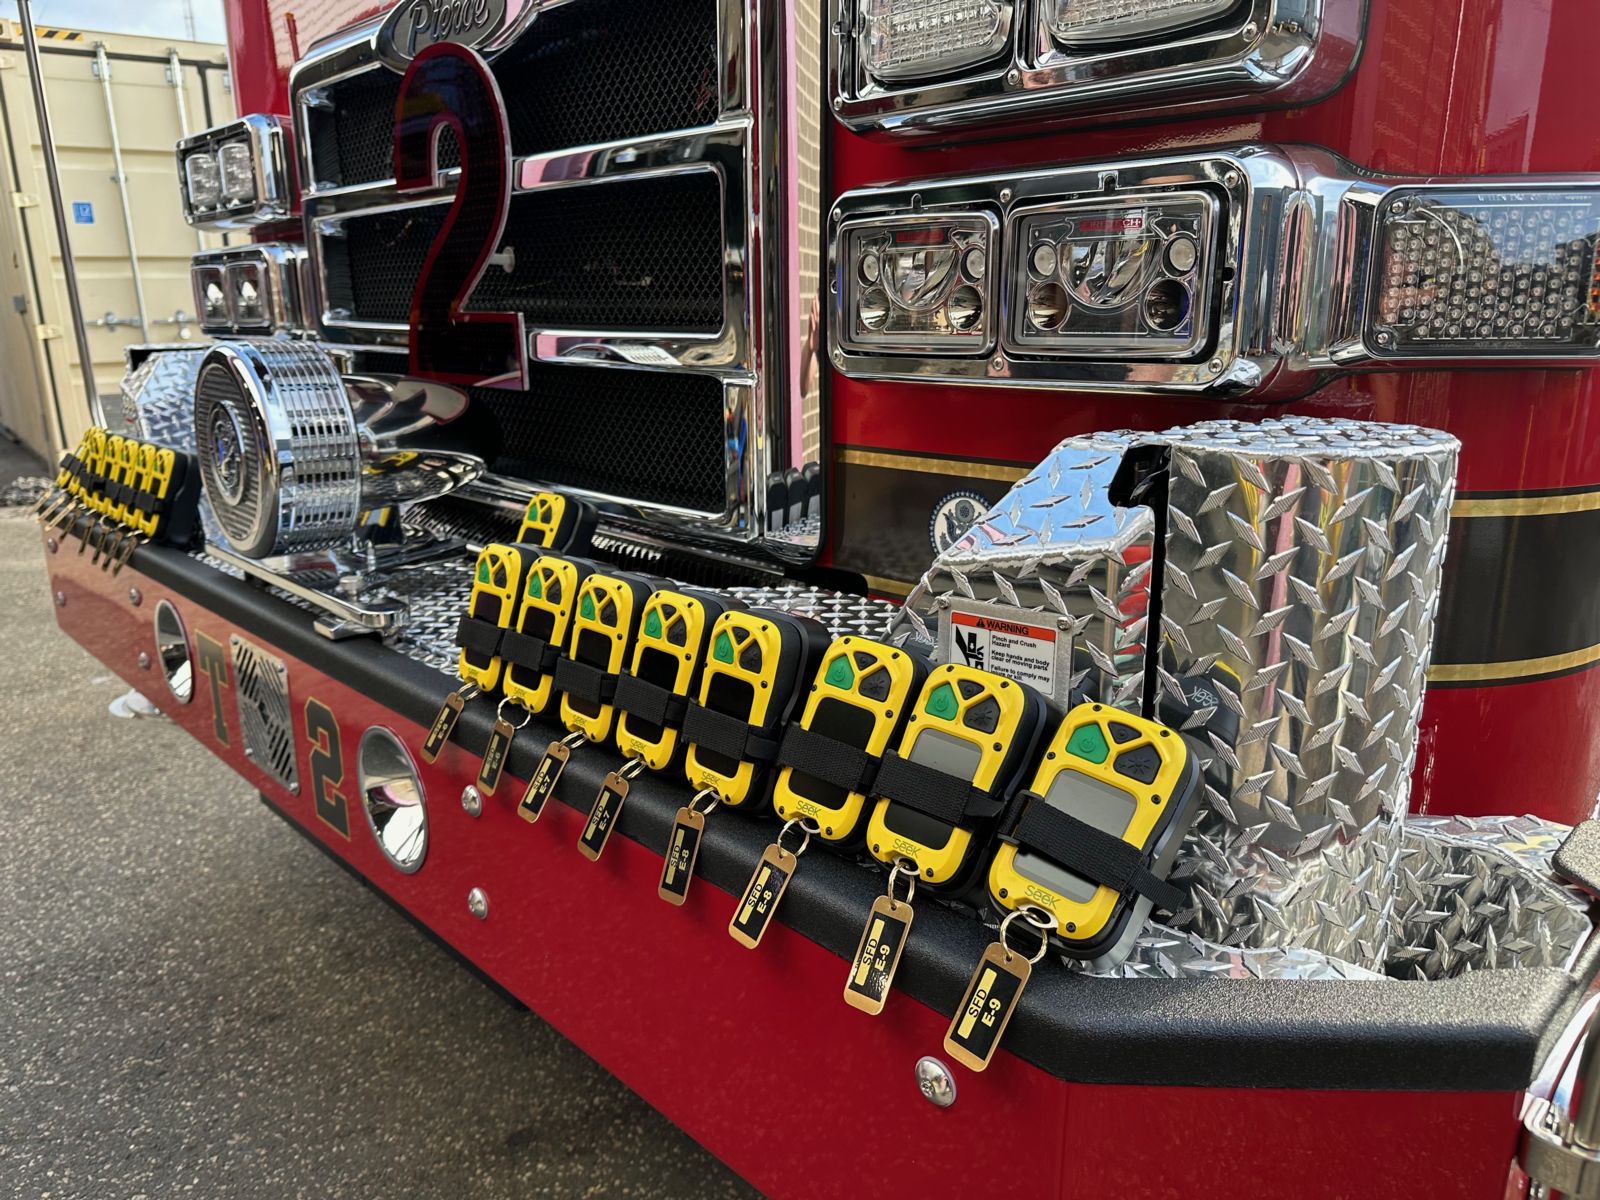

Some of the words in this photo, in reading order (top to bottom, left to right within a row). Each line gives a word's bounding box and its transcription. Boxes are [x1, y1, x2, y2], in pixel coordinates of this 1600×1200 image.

[407, 0, 490, 56] Pierce
[393, 41, 530, 391] 2
[986, 619, 1029, 635] WARNING
[991, 640, 1011, 648] Hazard
[1019, 640, 1037, 648] Crush
[991, 649, 1006, 658] Keep
[1006, 652, 1023, 661] hands
[1035, 658, 1050, 668] body
[991, 655, 1005, 663] clear
[1011, 660, 1033, 669] moving
[1033, 663, 1048, 671] parts
[991, 664, 1009, 673] Failure
[1016, 670, 1037, 680] comply
[194, 628, 229, 748] T
[304, 696, 351, 842] 2
[538, 774, 551, 794] E-7
[598, 809, 610, 831] E-7
[670, 844, 681, 869] SFD
[678, 849, 690, 871] E-8
[747, 883, 764, 908] SFD
[756, 889, 773, 914] E-8
[862, 938, 878, 966] SFD
[874, 944, 891, 972] E-9
[968, 988, 988, 1018] SFD
[981, 997, 1002, 1028] E-9
